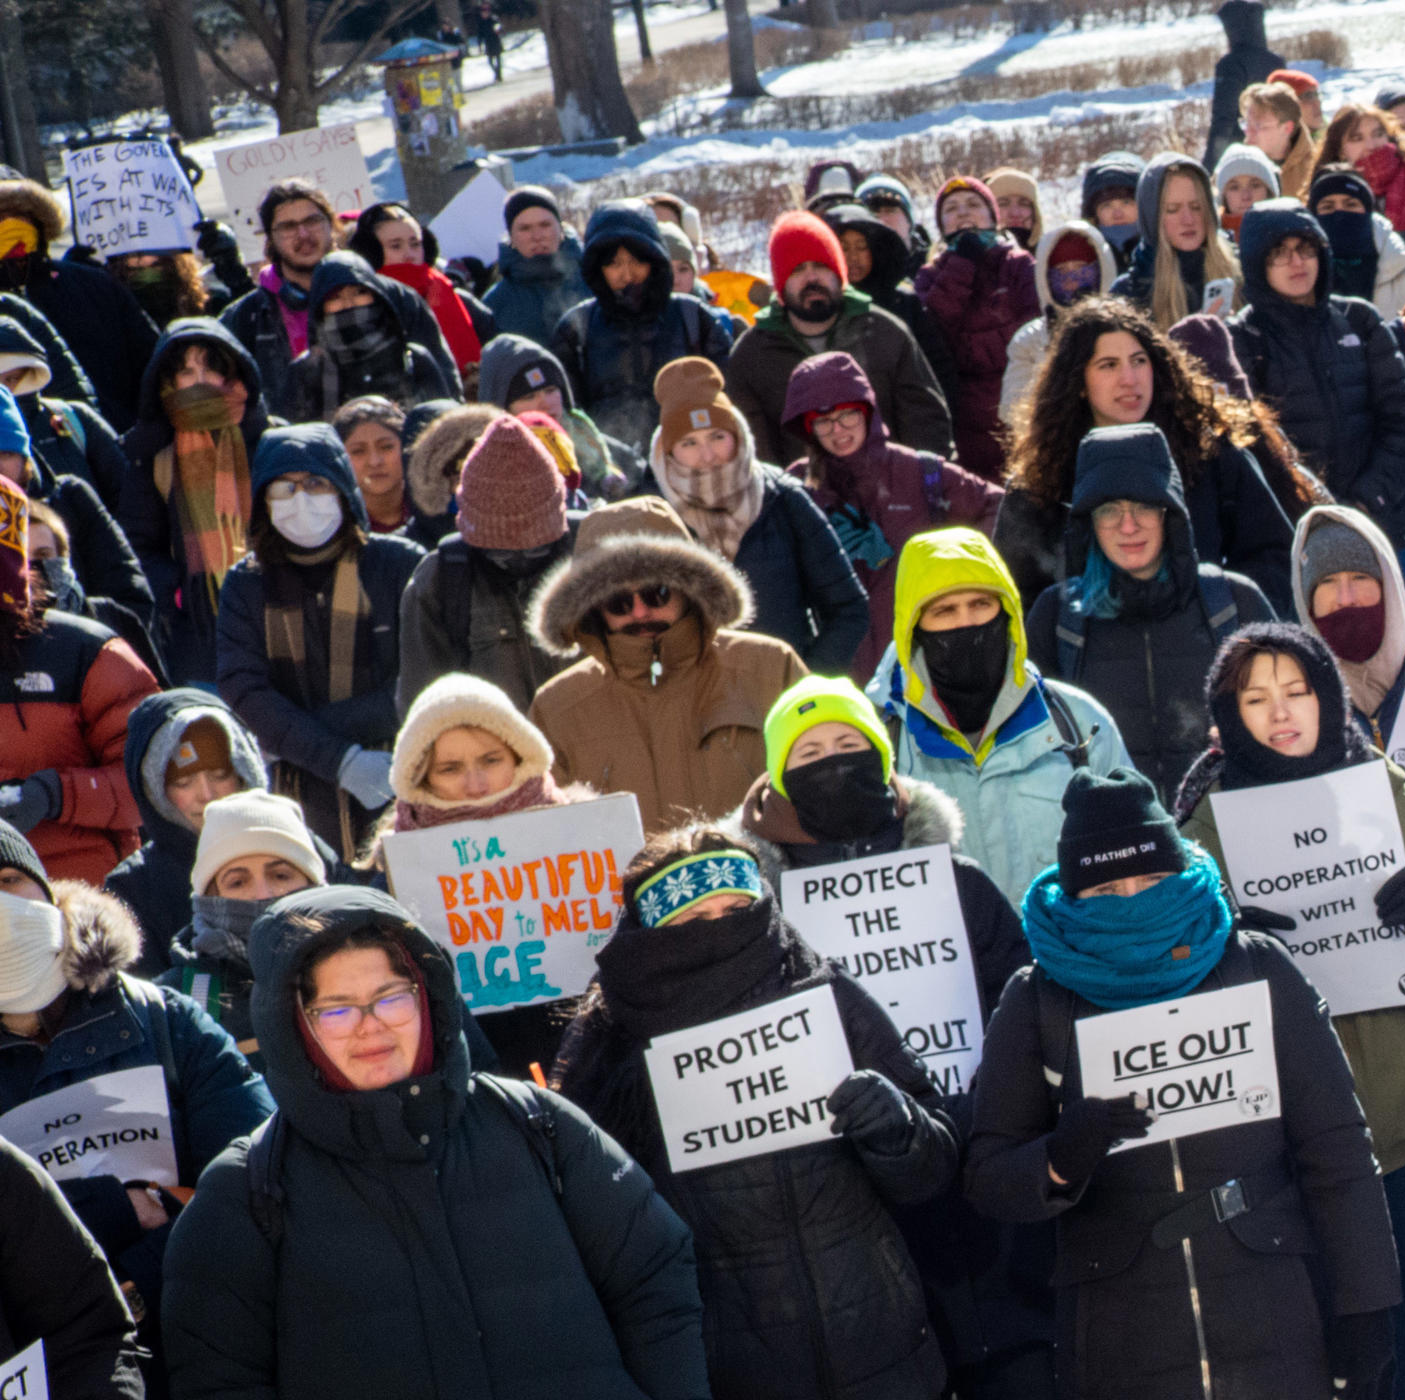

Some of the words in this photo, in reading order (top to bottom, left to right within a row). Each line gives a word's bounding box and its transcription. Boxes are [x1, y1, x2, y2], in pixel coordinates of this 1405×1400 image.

[71, 147, 104, 172] THE
[226, 137, 298, 176] GOLDY
[74, 173, 107, 199] IS
[118, 167, 145, 192] AT
[78, 197, 133, 227] WITH
[138, 193, 176, 218] ITS
[85, 220, 149, 251] PEOPLE
[485, 836, 506, 861] a
[1094, 846, 1137, 864] RATHER
[1293, 827, 1328, 849] NO
[437, 848, 624, 911] BEAUTIFUL
[803, 859, 930, 904] PROTECT
[1243, 849, 1397, 898] COOPERATION
[446, 906, 505, 947] DAY
[515, 909, 537, 937] to
[845, 906, 902, 938] THE
[1299, 897, 1357, 922] WITH
[455, 939, 552, 1001] ICE
[841, 937, 959, 979] UDENTS
[673, 1007, 812, 1080] PROTECT
[1113, 1040, 1168, 1077] ICE
[1178, 1020, 1252, 1063] OUT
[725, 1065, 789, 1105] THE
[44, 1113, 83, 1134] NO
[682, 1095, 828, 1154] STUDENT
[38, 1127, 160, 1171] PERATION
